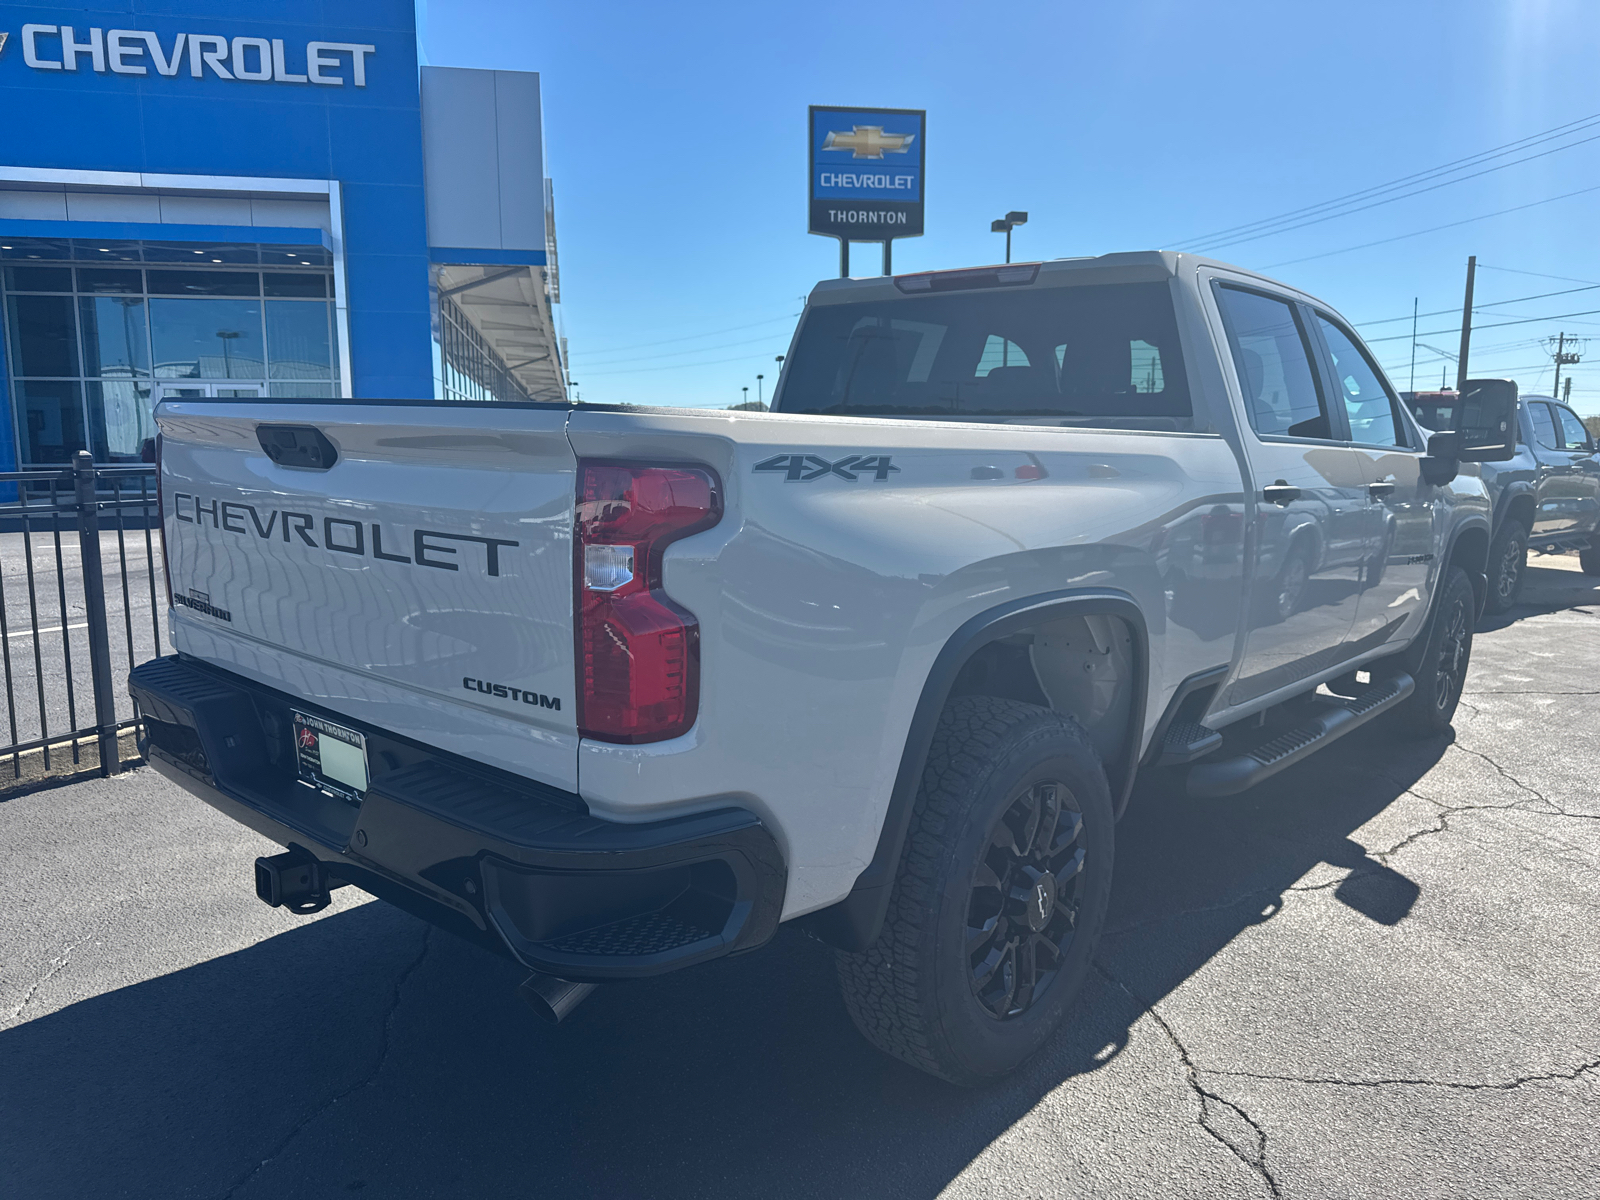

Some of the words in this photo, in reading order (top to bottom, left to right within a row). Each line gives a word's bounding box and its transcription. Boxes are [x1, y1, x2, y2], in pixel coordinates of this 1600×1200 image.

[21, 23, 376, 86] CHEVROLET
[820, 173, 914, 189] CHEVROLET
[828, 210, 907, 224] THORNTON
[174, 492, 519, 577] CHEVROLET
[463, 677, 561, 711] CUSTOM
[306, 717, 324, 731] JOHN
[325, 723, 361, 745] THORNTON
